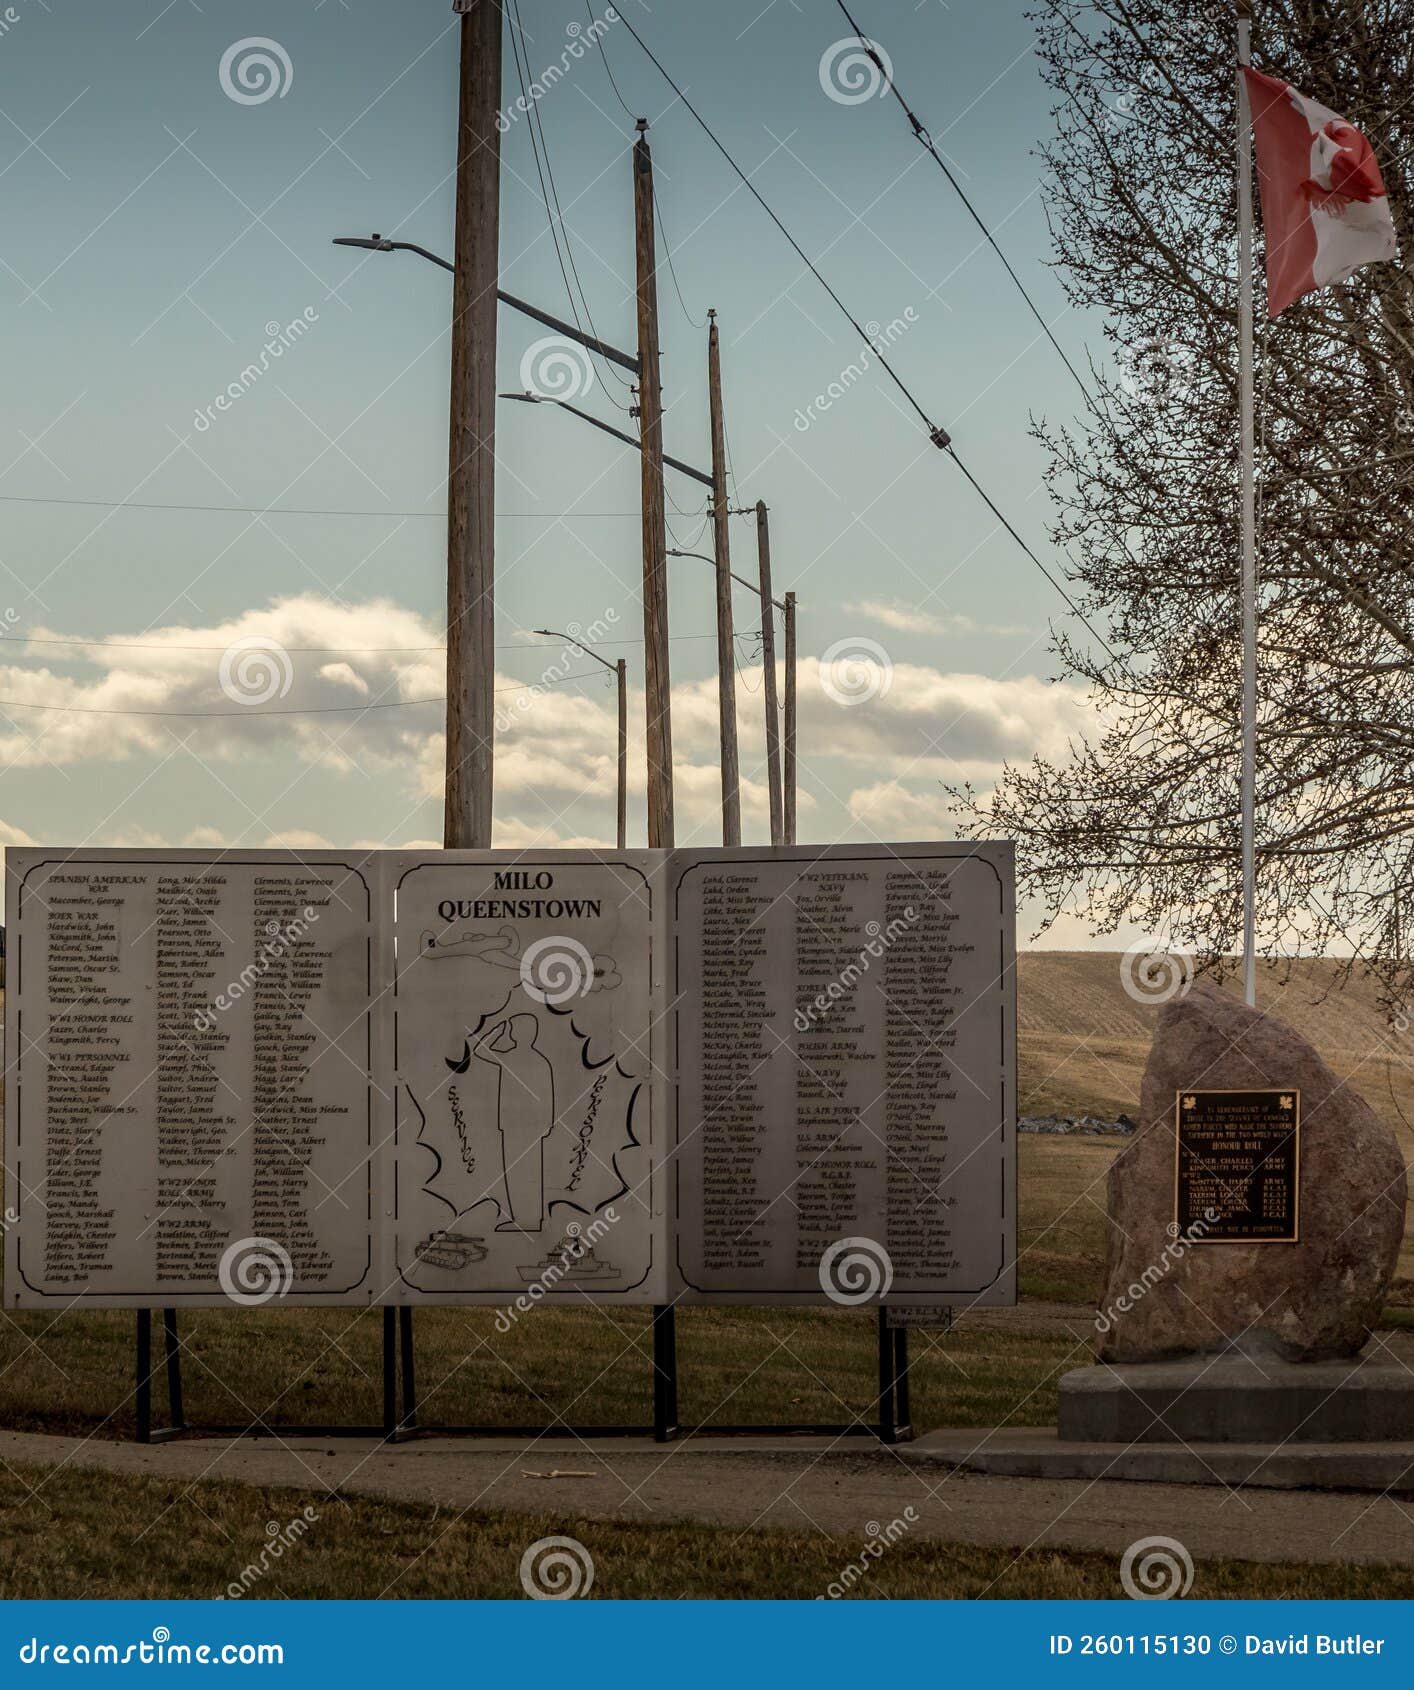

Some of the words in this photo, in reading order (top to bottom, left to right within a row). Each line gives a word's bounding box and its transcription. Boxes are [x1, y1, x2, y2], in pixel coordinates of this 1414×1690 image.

[493, 871, 554, 891] MILO
[295, 888, 308, 896] Joe
[97, 897, 125, 906] George
[438, 900, 602, 921] QUEENSTOWN
[77, 912, 99, 920] WAR
[95, 923, 114, 932] John
[181, 919, 206, 927] James
[96, 933, 116, 942] John
[195, 940, 221, 949] Henry
[83, 965, 107, 973] Oscar
[74, 975, 92, 983] Dan
[182, 992, 207, 1000] Frank
[103, 996, 131, 1006] George
[96, 1037, 120, 1046] Percy
[200, 1033, 230, 1043] Stanley
[287, 1033, 316, 1043] Stanley
[282, 1044, 309, 1053] George
[91, 1064, 115, 1073] Edgar
[80, 1085, 110, 1095] Stanley
[186, 1085, 217, 1093] Samuel
[194, 1096, 214, 1105] Fred
[189, 1107, 213, 1115] James
[447, 1086, 476, 1174] SERVICE
[566, 1075, 608, 1192] PERSONNEL
[191, 1138, 221, 1146] Gordon
[74, 1158, 100, 1166] David
[73, 1169, 101, 1178] George
[282, 1179, 308, 1189] Harry
[83, 1190, 97, 1198] Ben
[281, 1189, 300, 1198] John
[46, 1200, 64, 1209] Gay,
[68, 1200, 98, 1209] Mandy
[199, 1200, 226, 1210] Harry
[282, 1199, 299, 1207] Tom
[77, 1210, 114, 1218] Marshall
[83, 1221, 109, 1230] Frank
[288, 1220, 308, 1228] John
[291, 1240, 317, 1248] David
